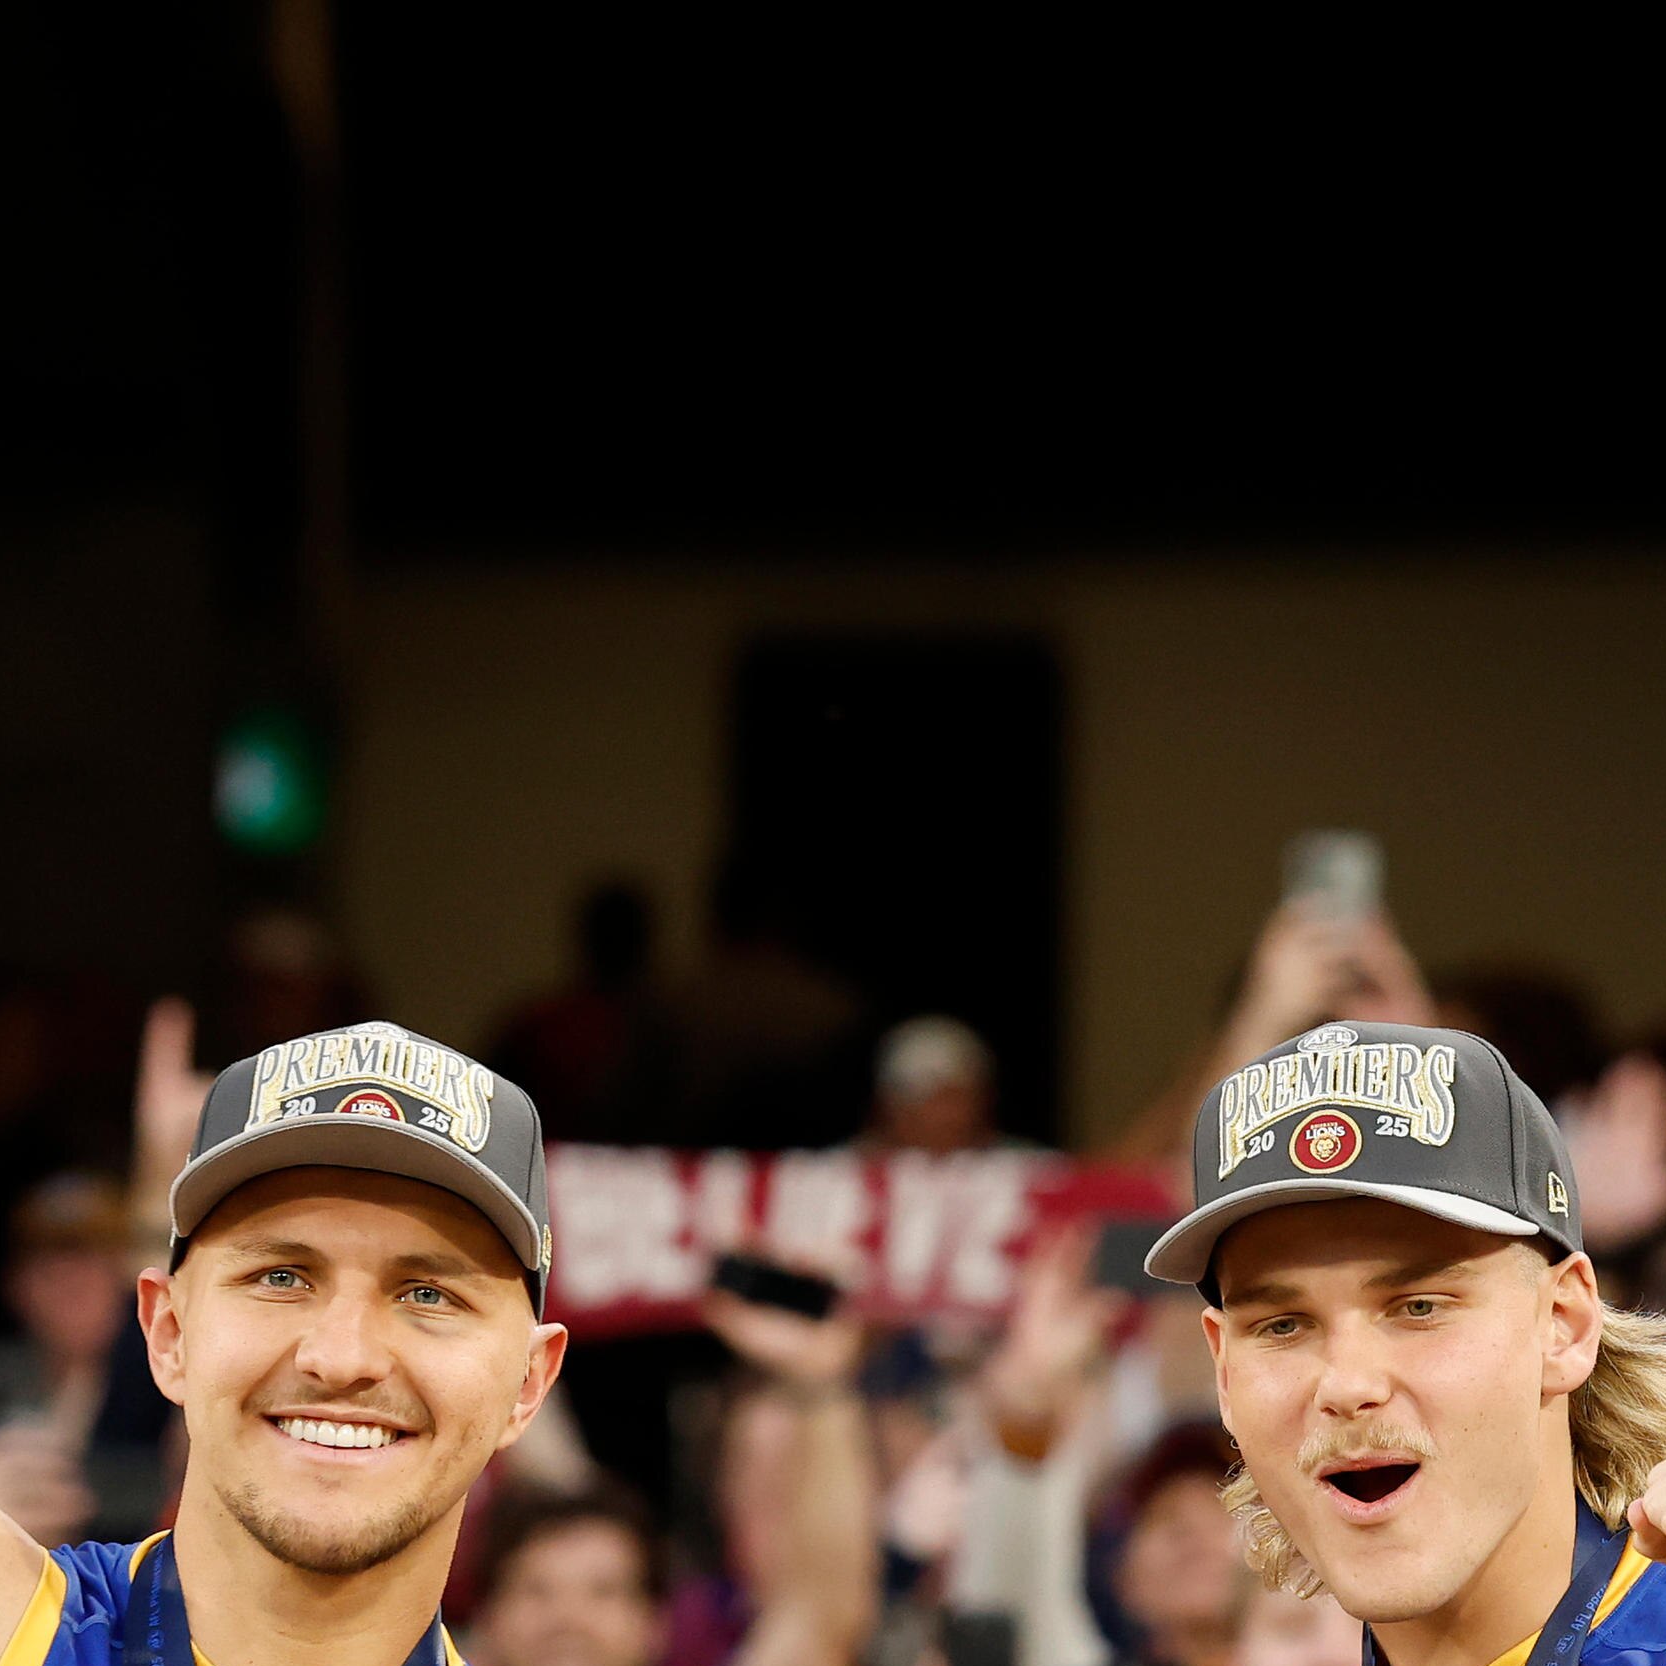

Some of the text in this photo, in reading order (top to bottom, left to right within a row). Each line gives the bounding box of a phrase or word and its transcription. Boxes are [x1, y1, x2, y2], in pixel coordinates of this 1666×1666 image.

[1303, 1031, 1352, 1048] AFL
[245, 1033, 493, 1153] PREMIERS
[1218, 1043, 1455, 1180] PREMIERS
[283, 1096, 450, 1133] 20 25
[1305, 1126, 1346, 1140] LIONS
[1246, 1117, 1410, 1159] 20 25
